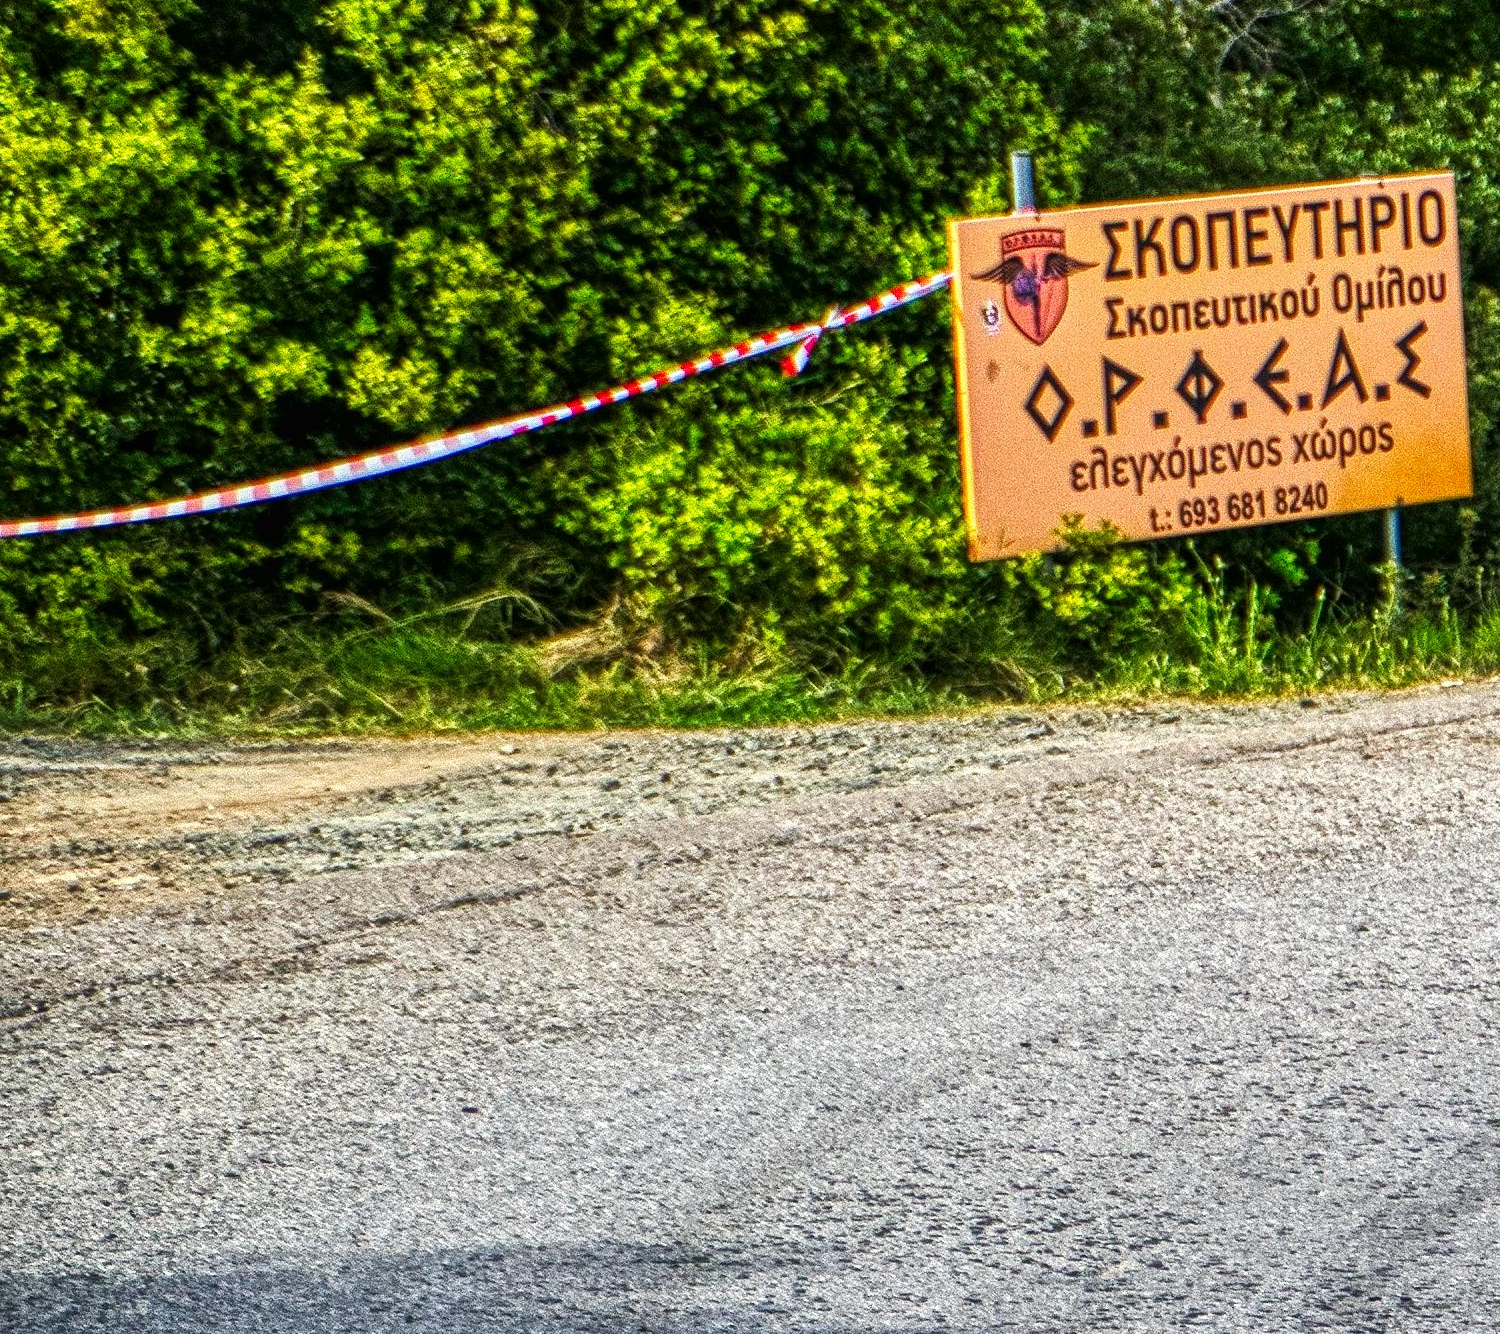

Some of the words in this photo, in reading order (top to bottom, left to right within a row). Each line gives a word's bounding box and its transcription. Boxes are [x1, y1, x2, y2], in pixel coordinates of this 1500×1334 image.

[1101, 189, 1446, 281] ΣΚΟΠΕΥΤΗΡΙΟ
[1106, 273, 1319, 340] Σκοπευτικού
[1333, 265, 1447, 323] Ομίλου
[1070, 436, 1282, 496] ελεγχόμενος
[1291, 417, 1395, 468] χώρος
[1179, 493, 1221, 527] 693
[1228, 489, 1266, 522] 681
[1275, 483, 1329, 517] 8240
